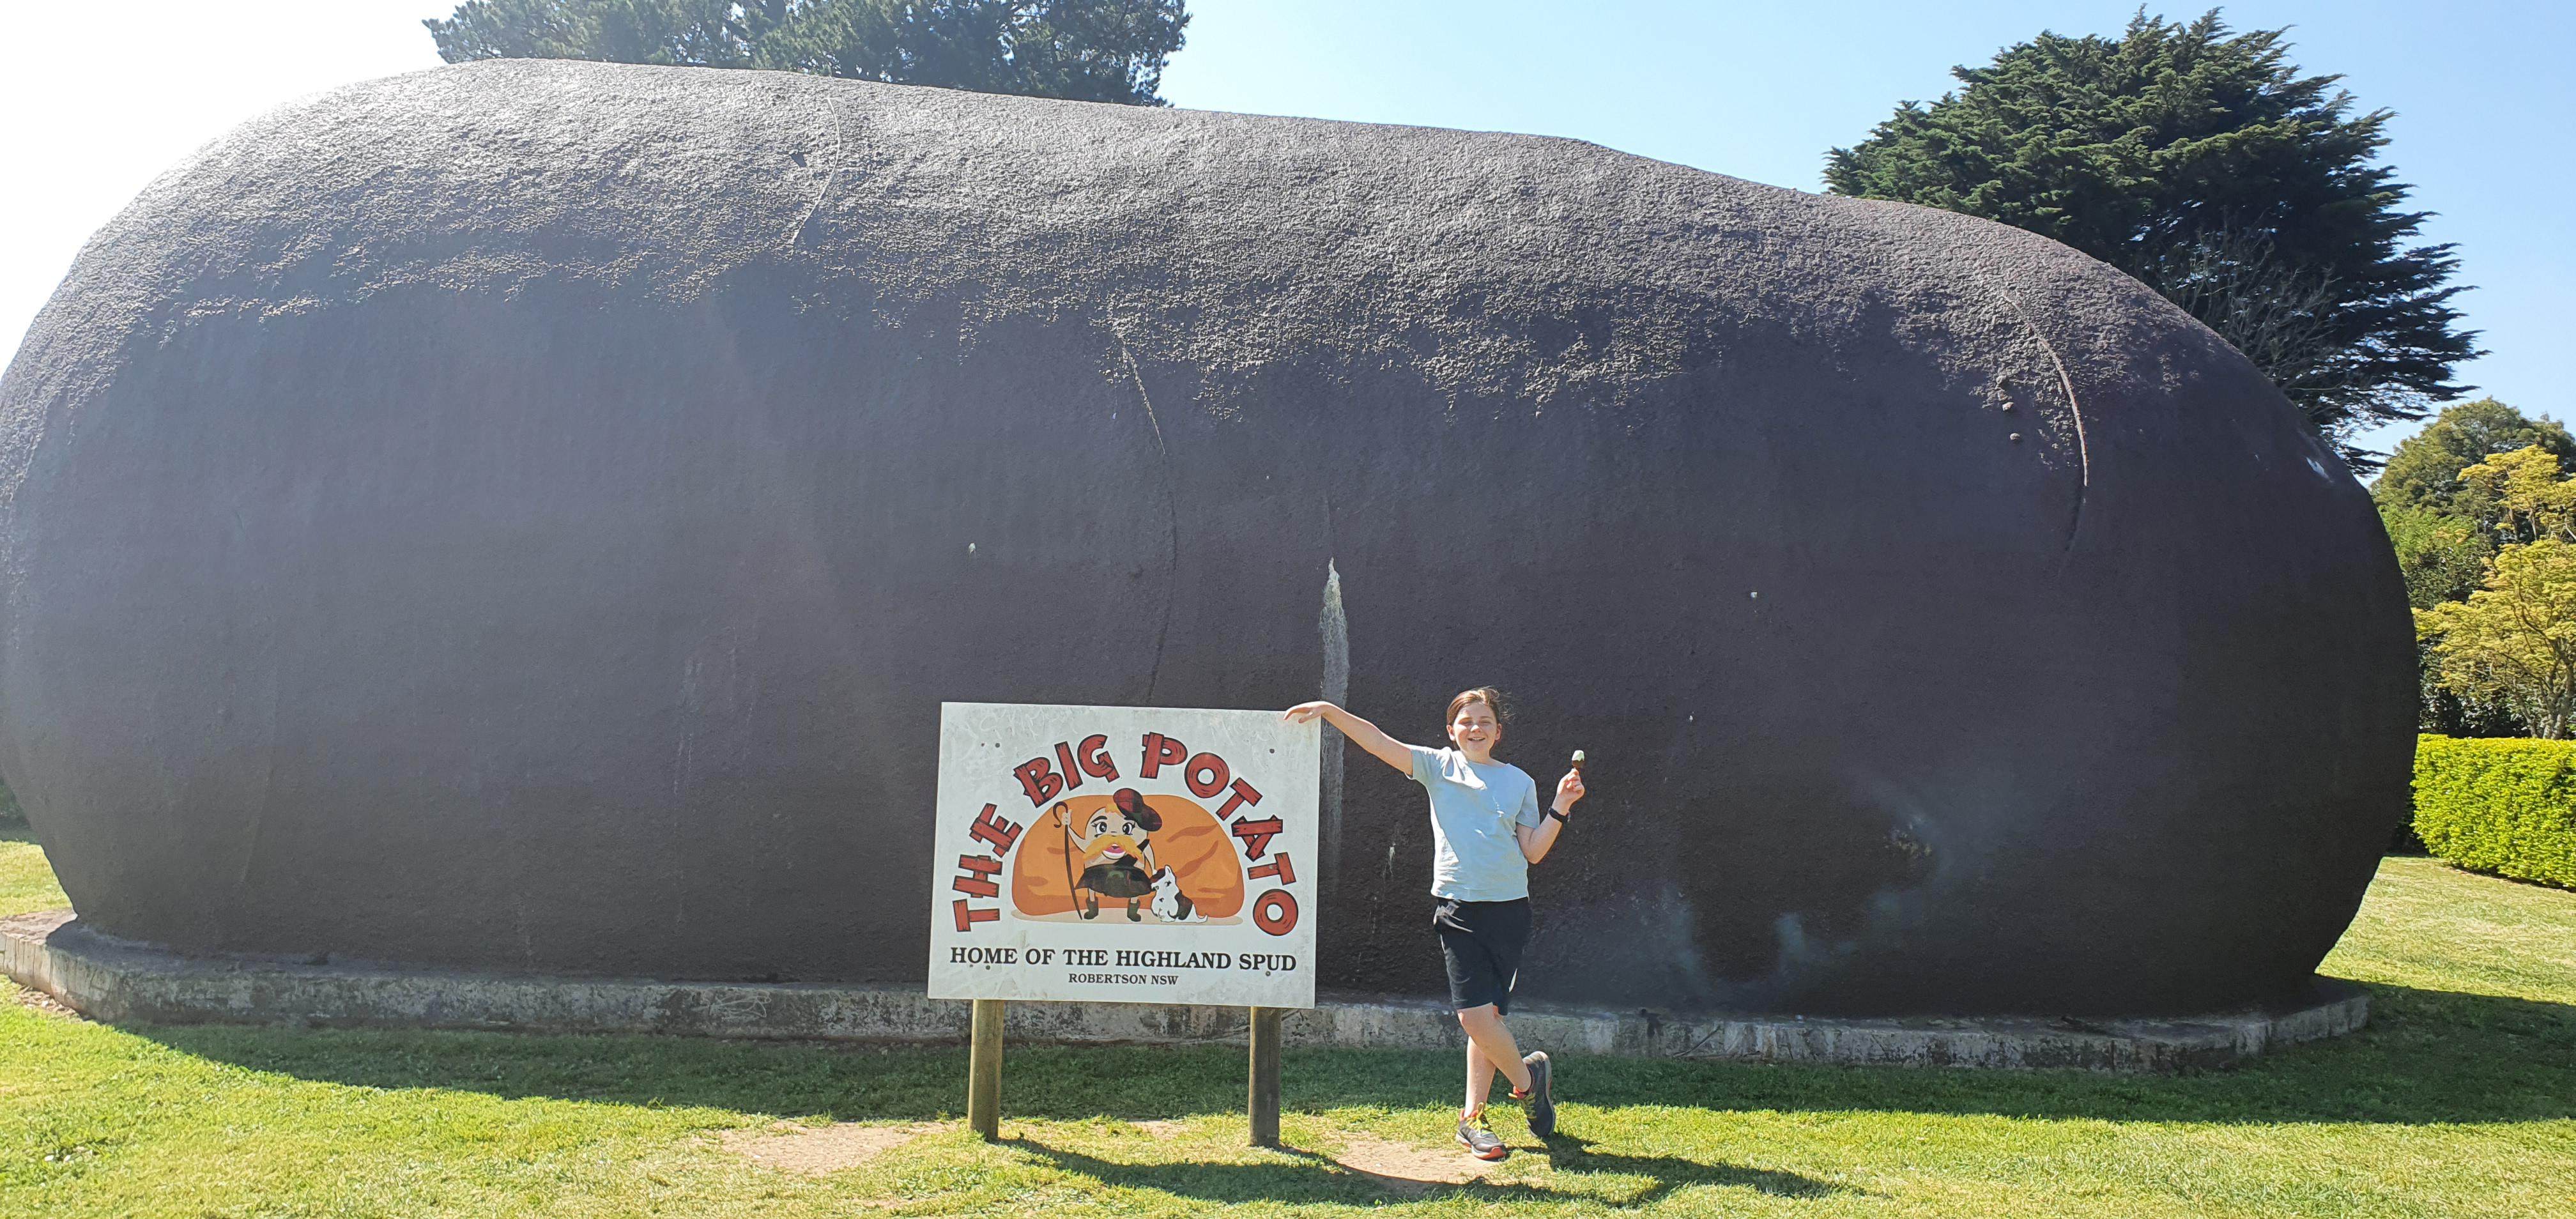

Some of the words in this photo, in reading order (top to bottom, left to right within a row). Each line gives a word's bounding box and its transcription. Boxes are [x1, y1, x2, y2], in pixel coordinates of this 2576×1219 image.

[952, 802, 1023, 932] THE
[1013, 733, 1121, 809] BIG
[1139, 732, 1299, 937] POTATO
[950, 947, 1018, 964] HOME
[1025, 948, 1055, 965] OF
[1062, 949, 1108, 966] THE
[1116, 950, 1231, 969] HIGHLAND
[1239, 953, 1297, 971] SPUD
[1068, 973, 1147, 985] ROBERTSON
[1151, 975, 1179, 985] NSW
